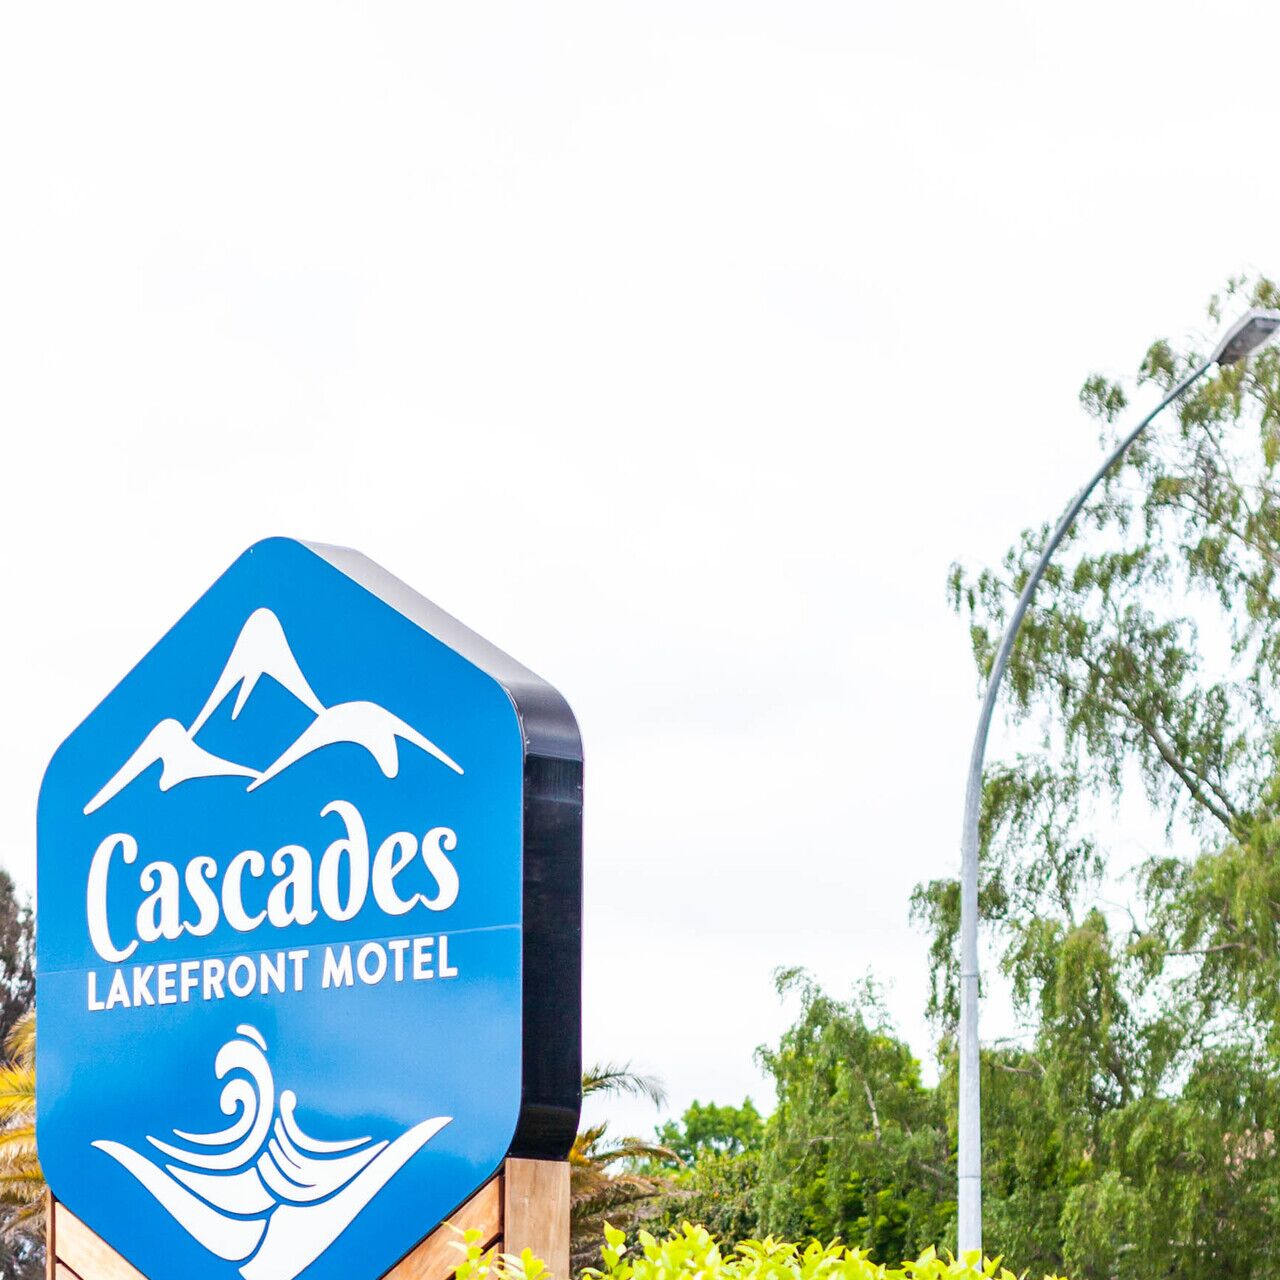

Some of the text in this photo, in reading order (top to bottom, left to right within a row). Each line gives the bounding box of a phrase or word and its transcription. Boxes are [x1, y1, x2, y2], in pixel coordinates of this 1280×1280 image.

[86, 799, 460, 963] Cascades
[87, 934, 459, 1012] LAKEFRONT MOTEL
